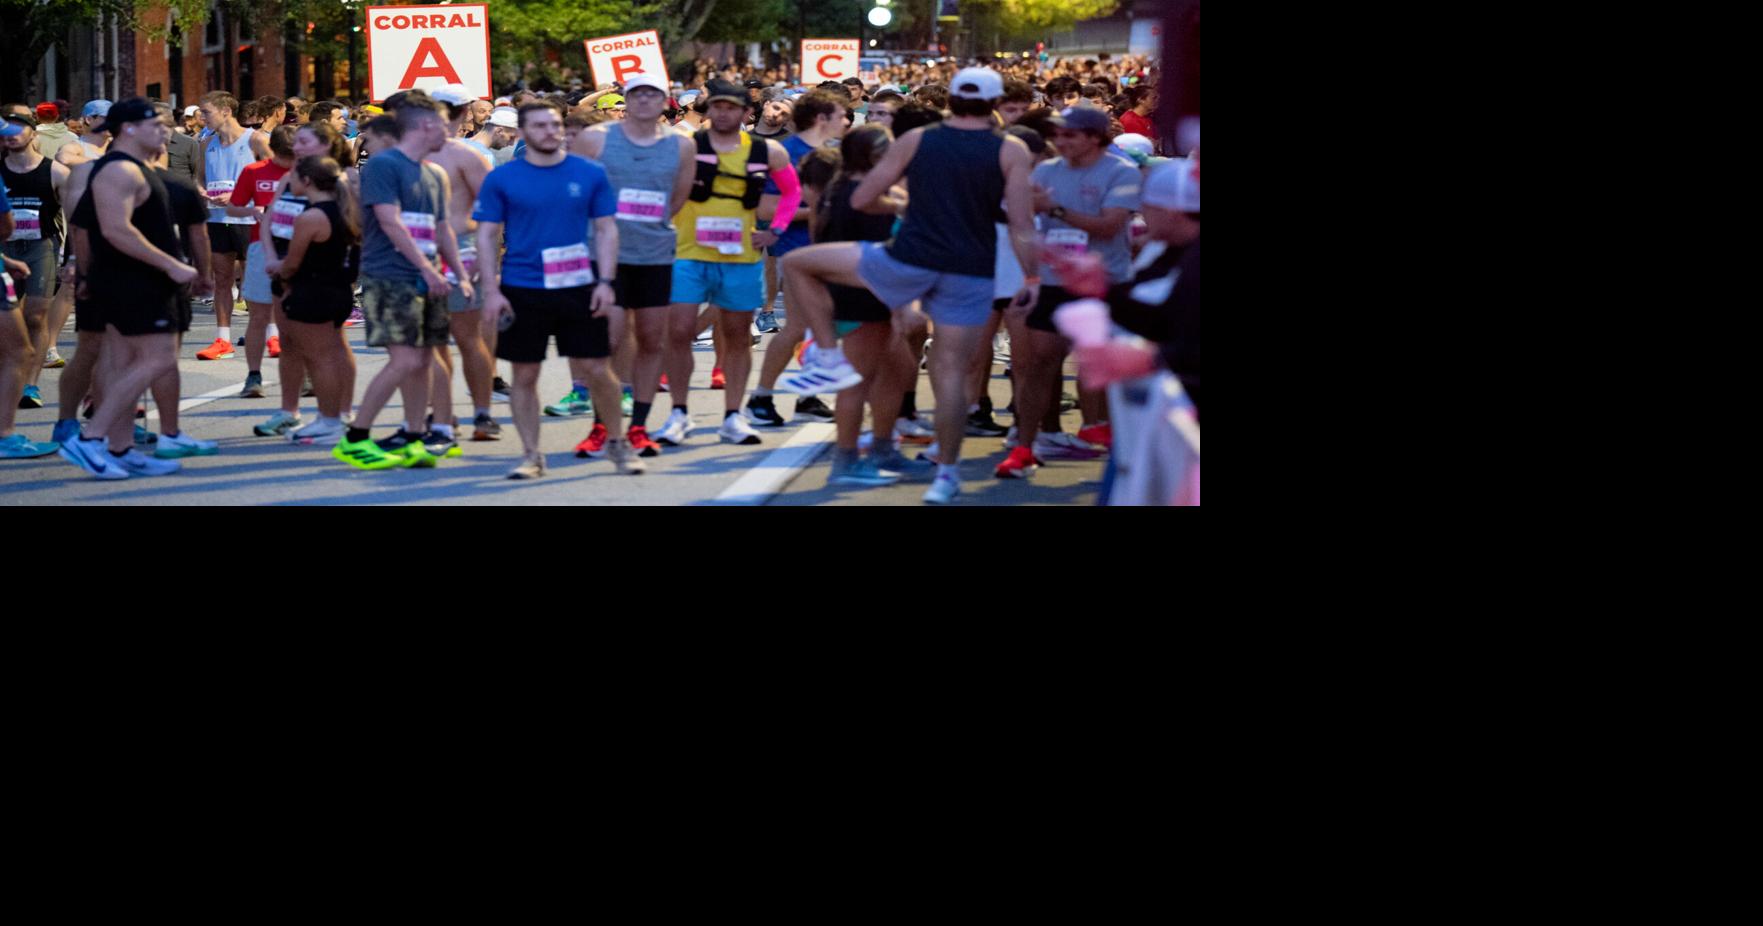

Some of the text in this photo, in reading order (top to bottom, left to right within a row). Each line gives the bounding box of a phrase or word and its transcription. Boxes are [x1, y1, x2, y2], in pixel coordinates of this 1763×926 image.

[374, 13, 481, 30] CORRAL
[591, 37, 655, 54] CORRAL
[397, 37, 463, 89] A
[611, 54, 645, 87] B
[816, 54, 843, 78] C
